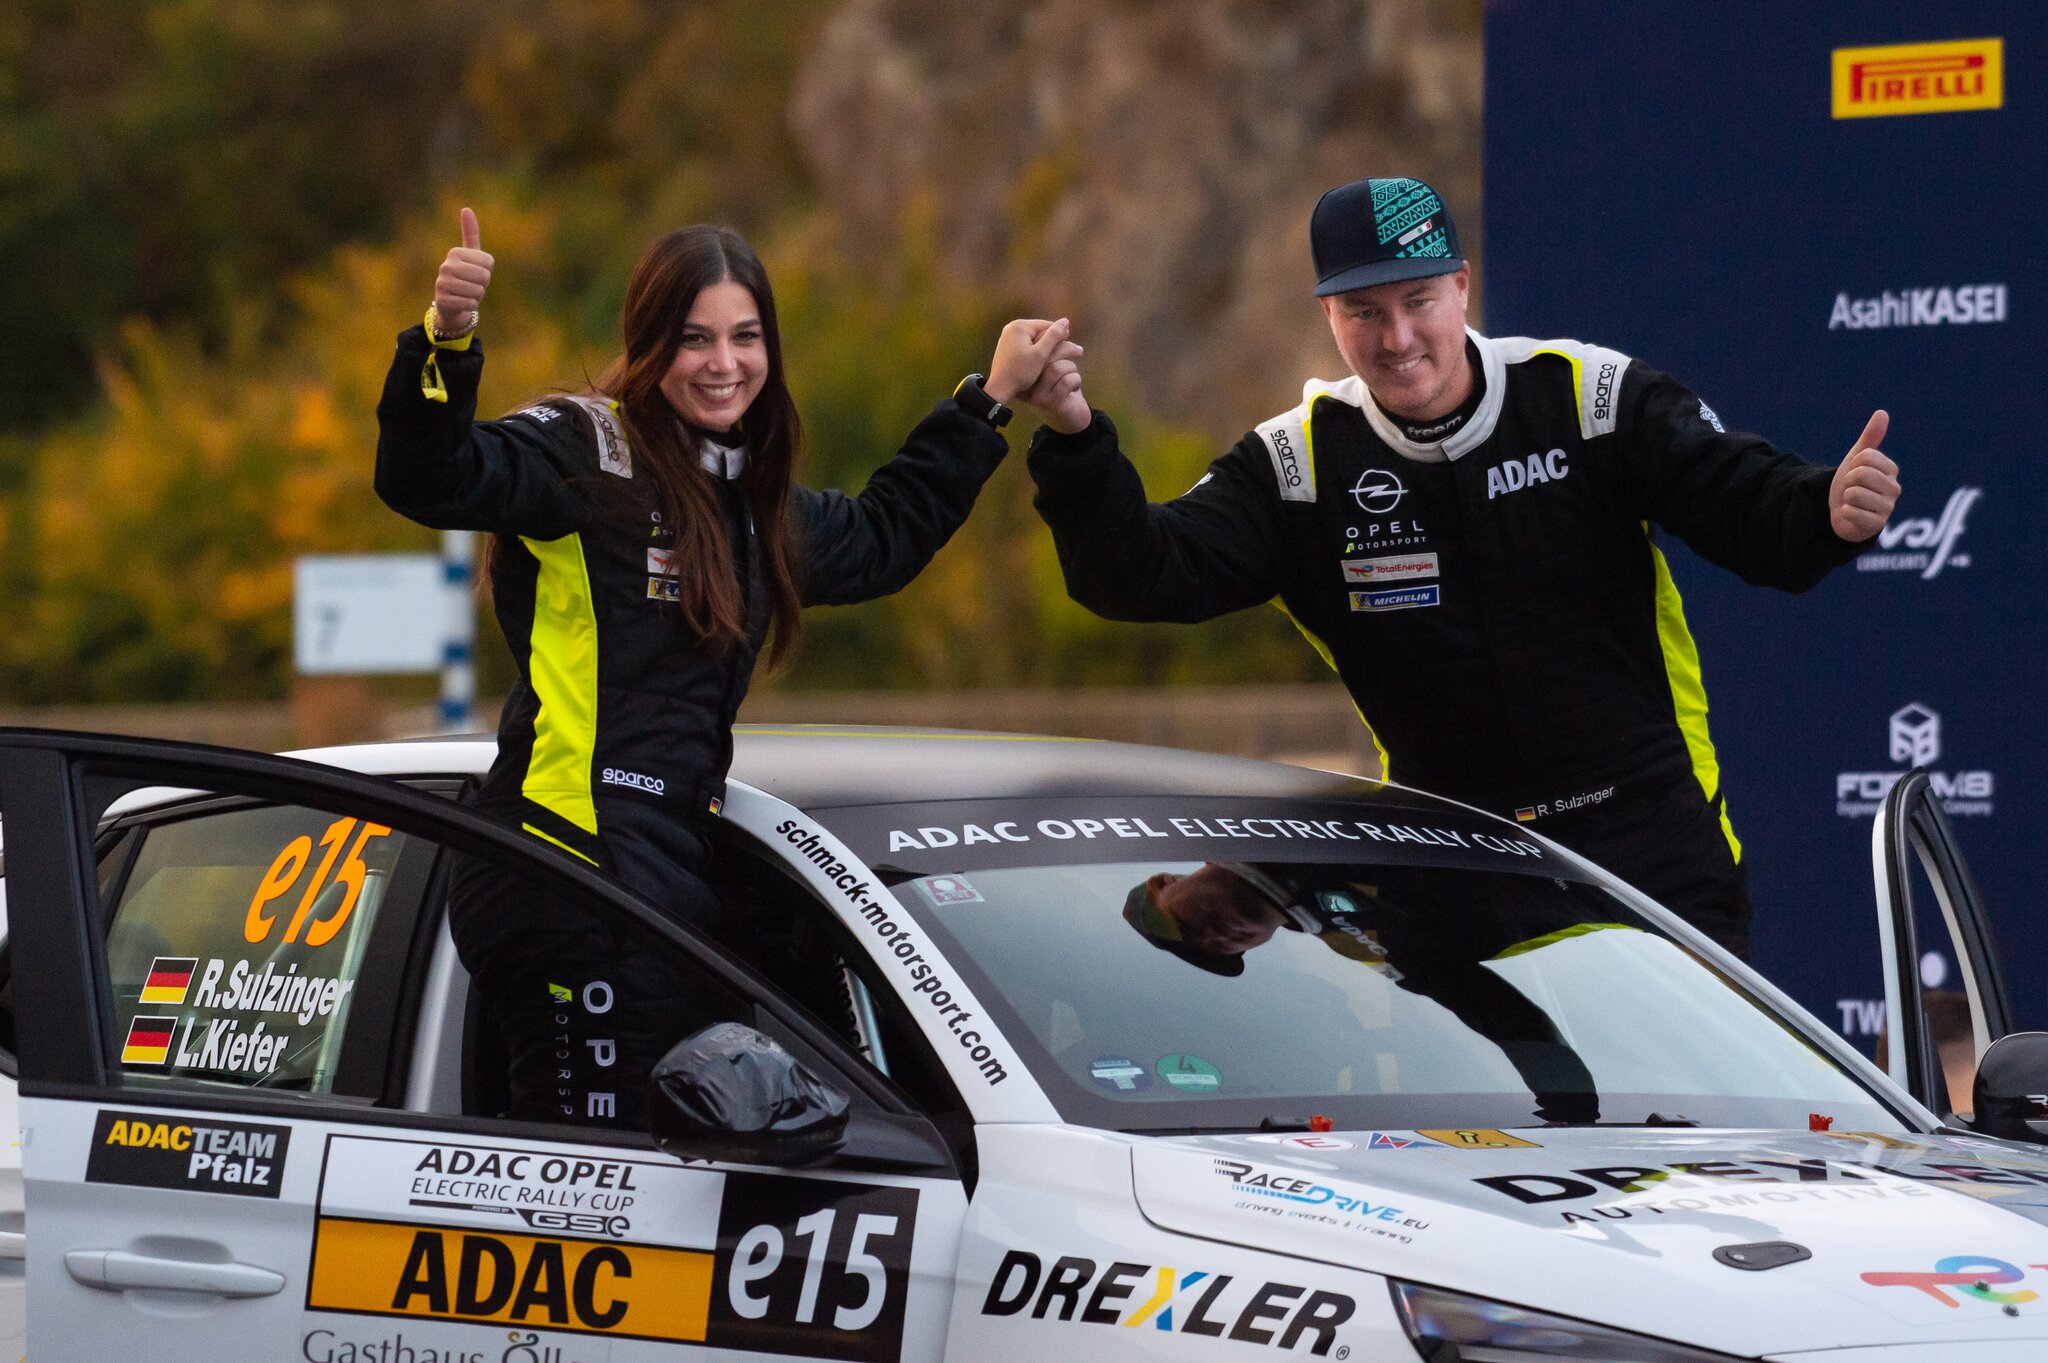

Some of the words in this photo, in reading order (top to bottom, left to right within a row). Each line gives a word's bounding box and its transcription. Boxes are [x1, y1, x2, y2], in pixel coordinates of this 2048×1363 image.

[1850, 55, 1985, 103] PIRELLI
[1828, 284, 2007, 330] AsahiKASEI
[1594, 363, 1615, 420] sparco
[1271, 429, 1301, 488] sparco
[1488, 449, 1569, 499] ADAC
[1346, 520, 1424, 538] OPEL
[1346, 536, 1427, 552] MOTORSPORT
[1376, 562, 1434, 574] TotalEnergies
[1374, 592, 1431, 606] MICHELIN
[602, 768, 665, 793] sparco
[1538, 804, 1553, 817] R.
[1555, 786, 1615, 812] Sulzinger
[889, 821, 1030, 852] ADAC
[1036, 818, 1168, 840] OPEL
[1168, 818, 1360, 840] ELECTRIC
[1355, 822, 1471, 849] RALLY
[1471, 833, 1543, 859] CUP
[245, 816, 391, 947] e15
[776, 819, 1008, 1086] schmack-motorsport.com
[194, 959, 355, 1026] R.Sulzinger
[1837, 1000, 1887, 1036] TW
[175, 1017, 289, 1073] L.Kiefer
[553, 988, 573, 1116] MOTORSP
[583, 980, 616, 1118] OPE
[188, 1153, 271, 1185] Pfalz
[415, 1149, 531, 1181] ADAC
[540, 1159, 638, 1191] OPEL
[411, 1178, 513, 1201] ELECTRIC
[517, 1186, 586, 1208] RALLY
[589, 1194, 635, 1212] CUP
[1560, 1184, 1932, 1224] AUTOMOTIVE
[1234, 1201, 1284, 1217] driving
[1288, 1210, 1338, 1225] events
[1356, 1223, 1413, 1244] training
[390, 1231, 632, 1329] ADAC
[728, 1208, 899, 1331] e15
[981, 1250, 1357, 1357] DREXLER
